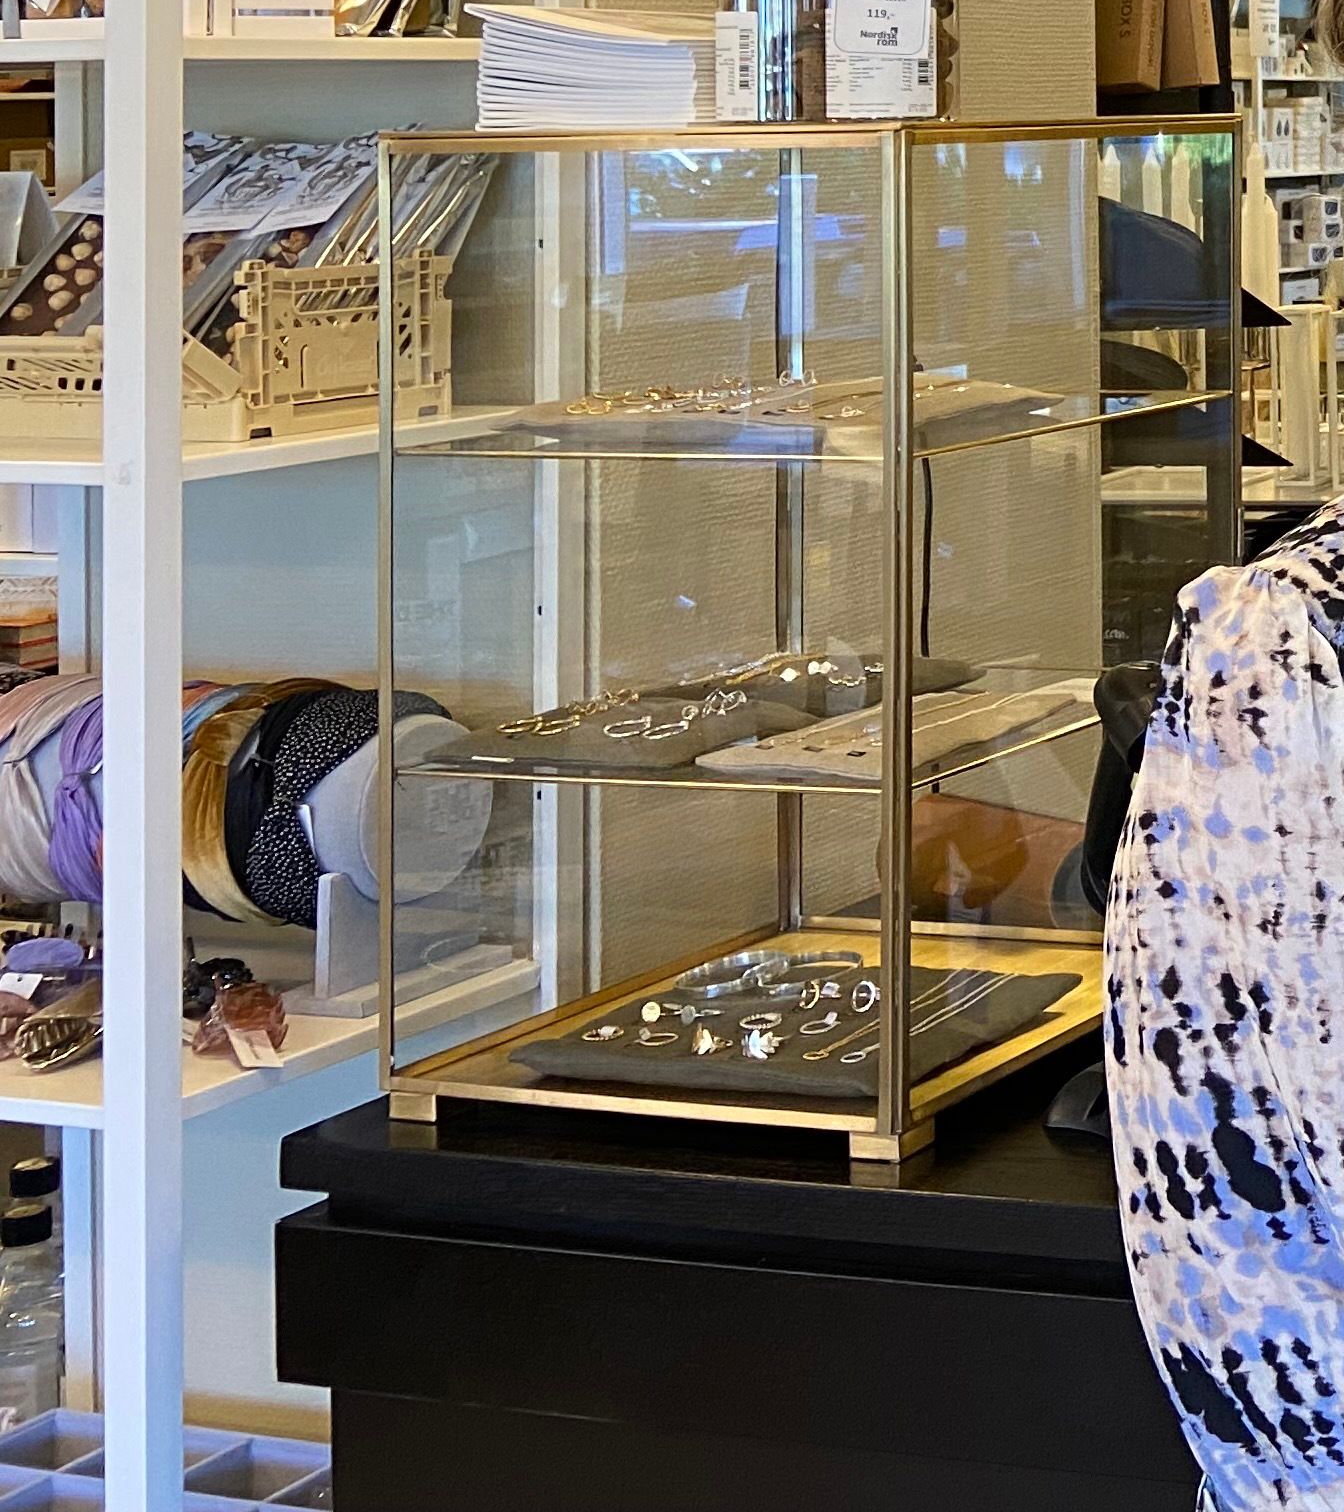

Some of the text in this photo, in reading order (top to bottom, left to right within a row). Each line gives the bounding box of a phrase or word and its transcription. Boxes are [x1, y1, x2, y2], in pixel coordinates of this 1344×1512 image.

[866, 8, 895, 20] 119,-
[1119, 29, 1131, 38] S
[876, 38, 898, 47] rom
